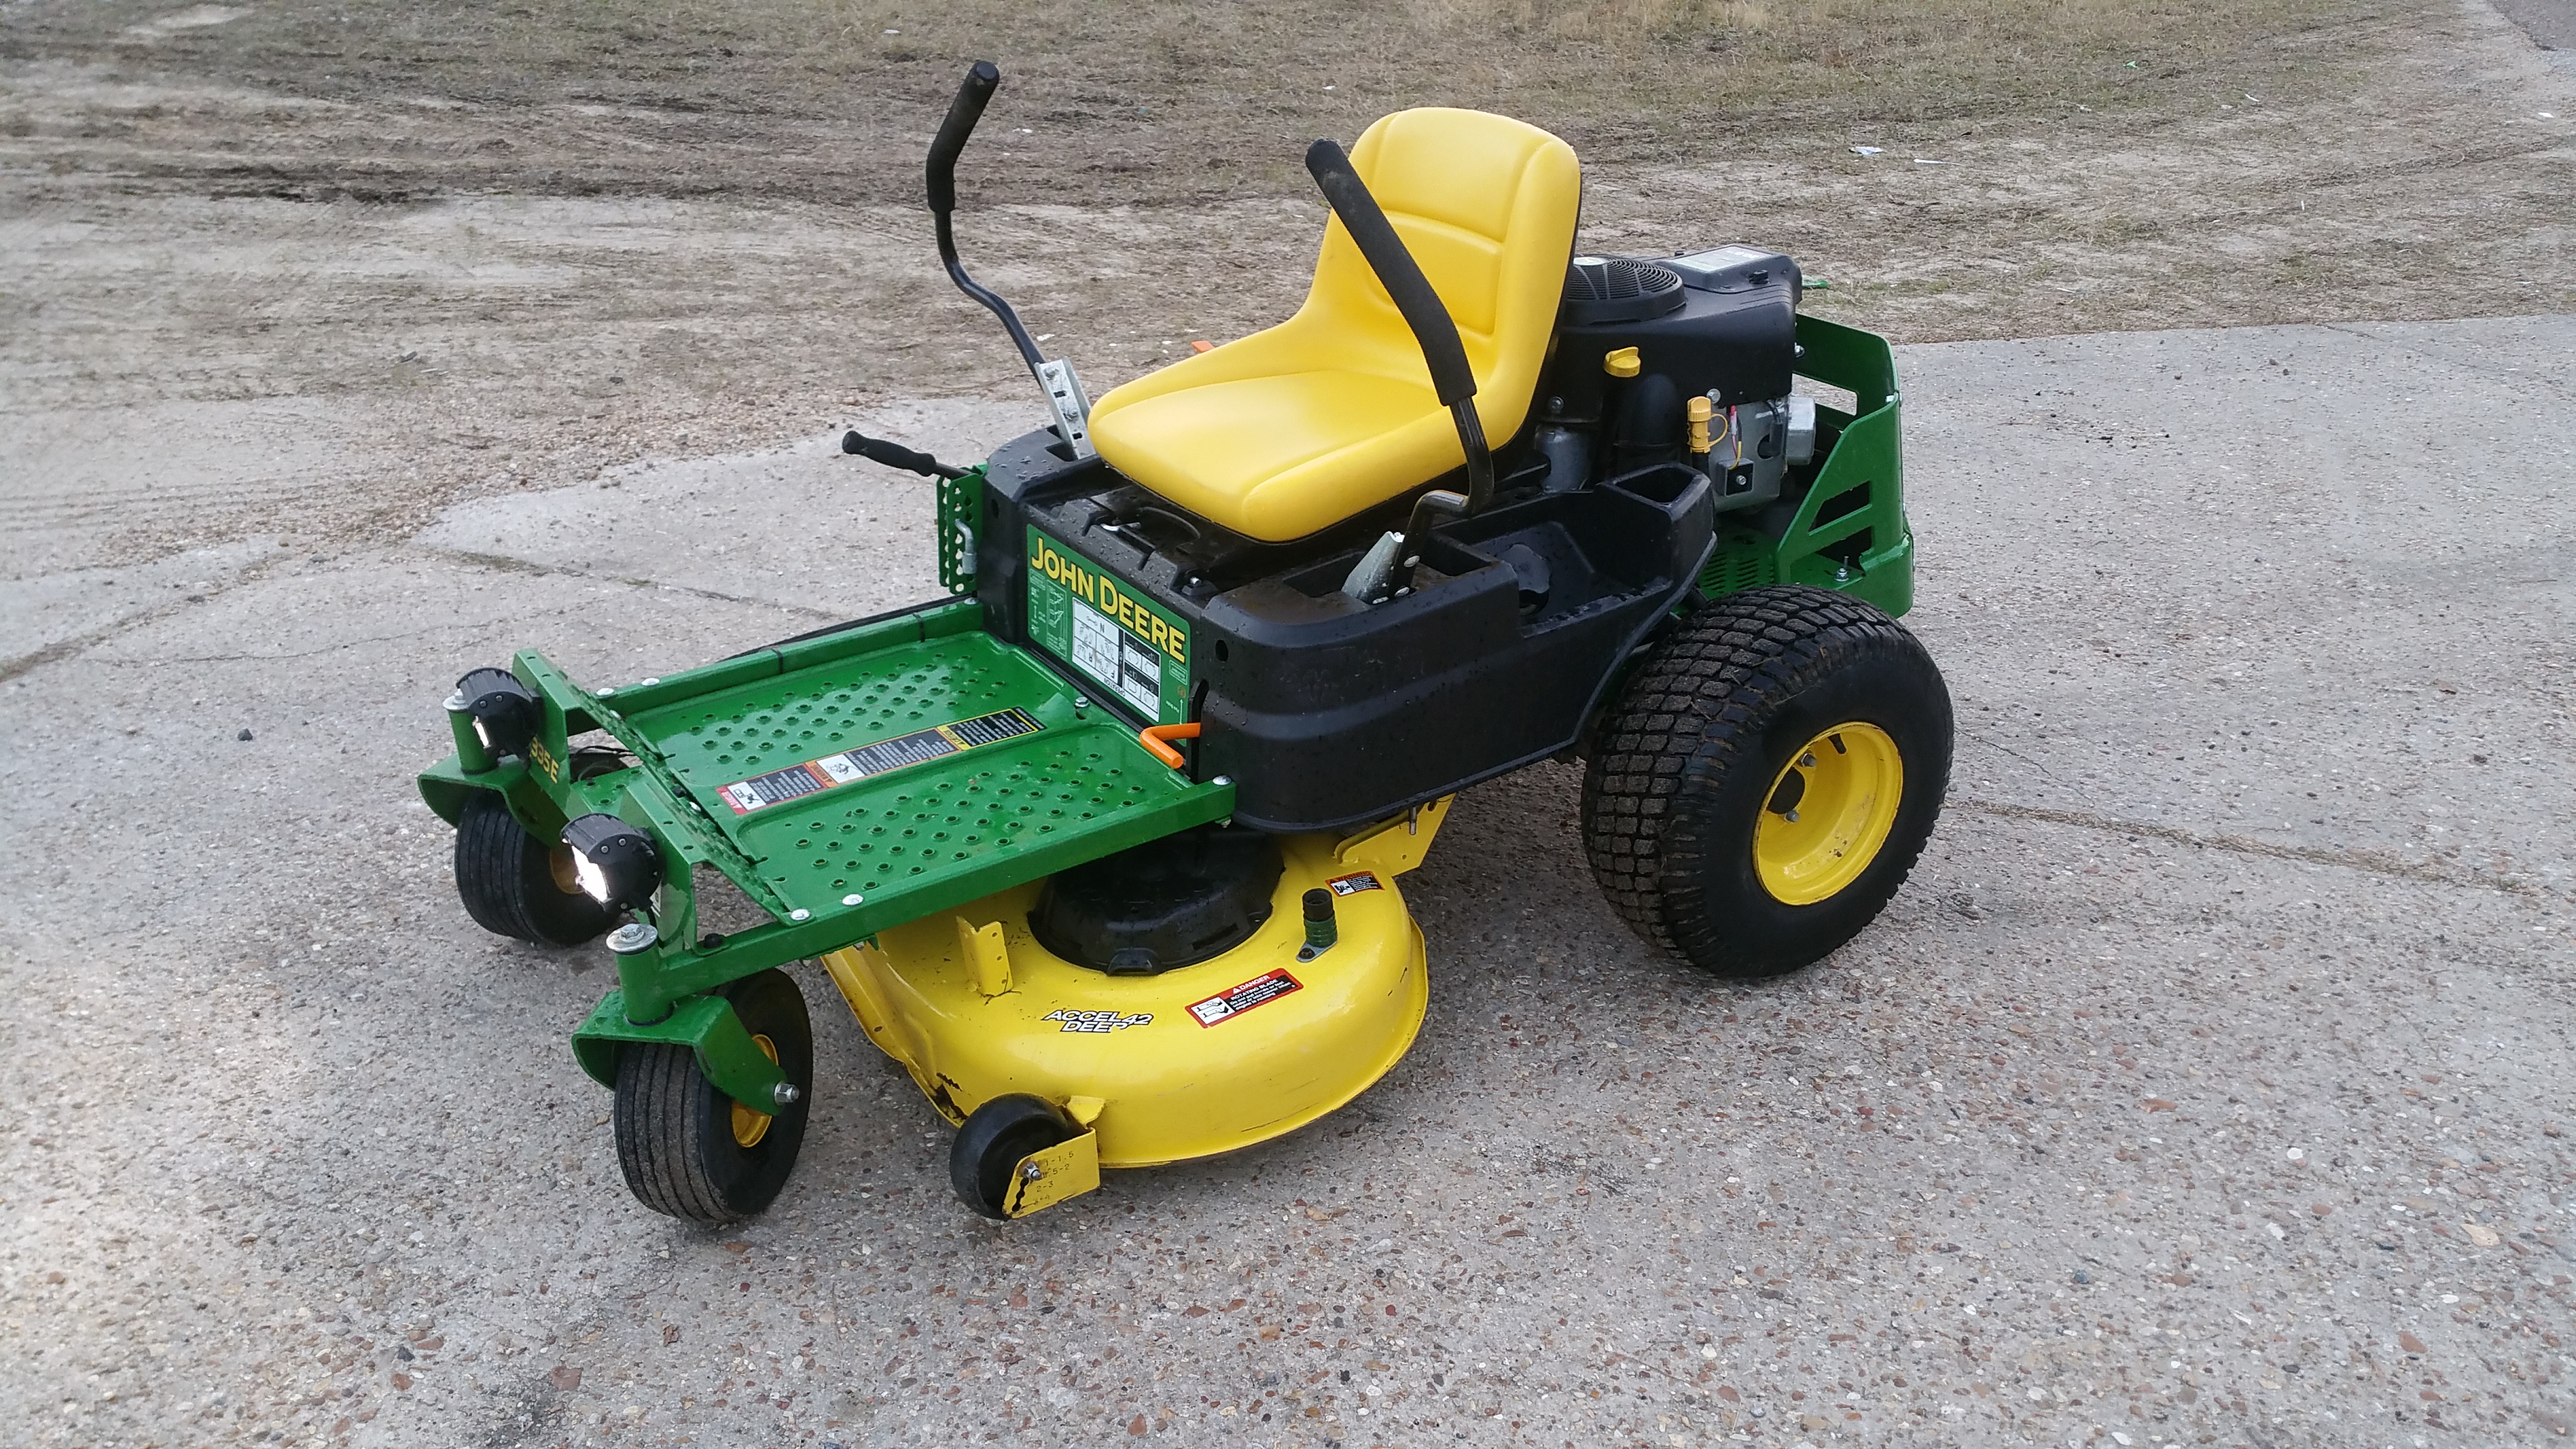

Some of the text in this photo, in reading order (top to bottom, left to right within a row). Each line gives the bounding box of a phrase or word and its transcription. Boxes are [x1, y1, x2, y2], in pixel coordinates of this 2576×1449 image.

[1031, 537, 1094, 604] JOHN
[1099, 575, 1186, 664] DEERE
[1230, 979, 1278, 1000] ROTATING BLADE
[1239, 975, 1271, 990] DANGER
[1042, 1010, 1154, 1025] ACCEL 42
